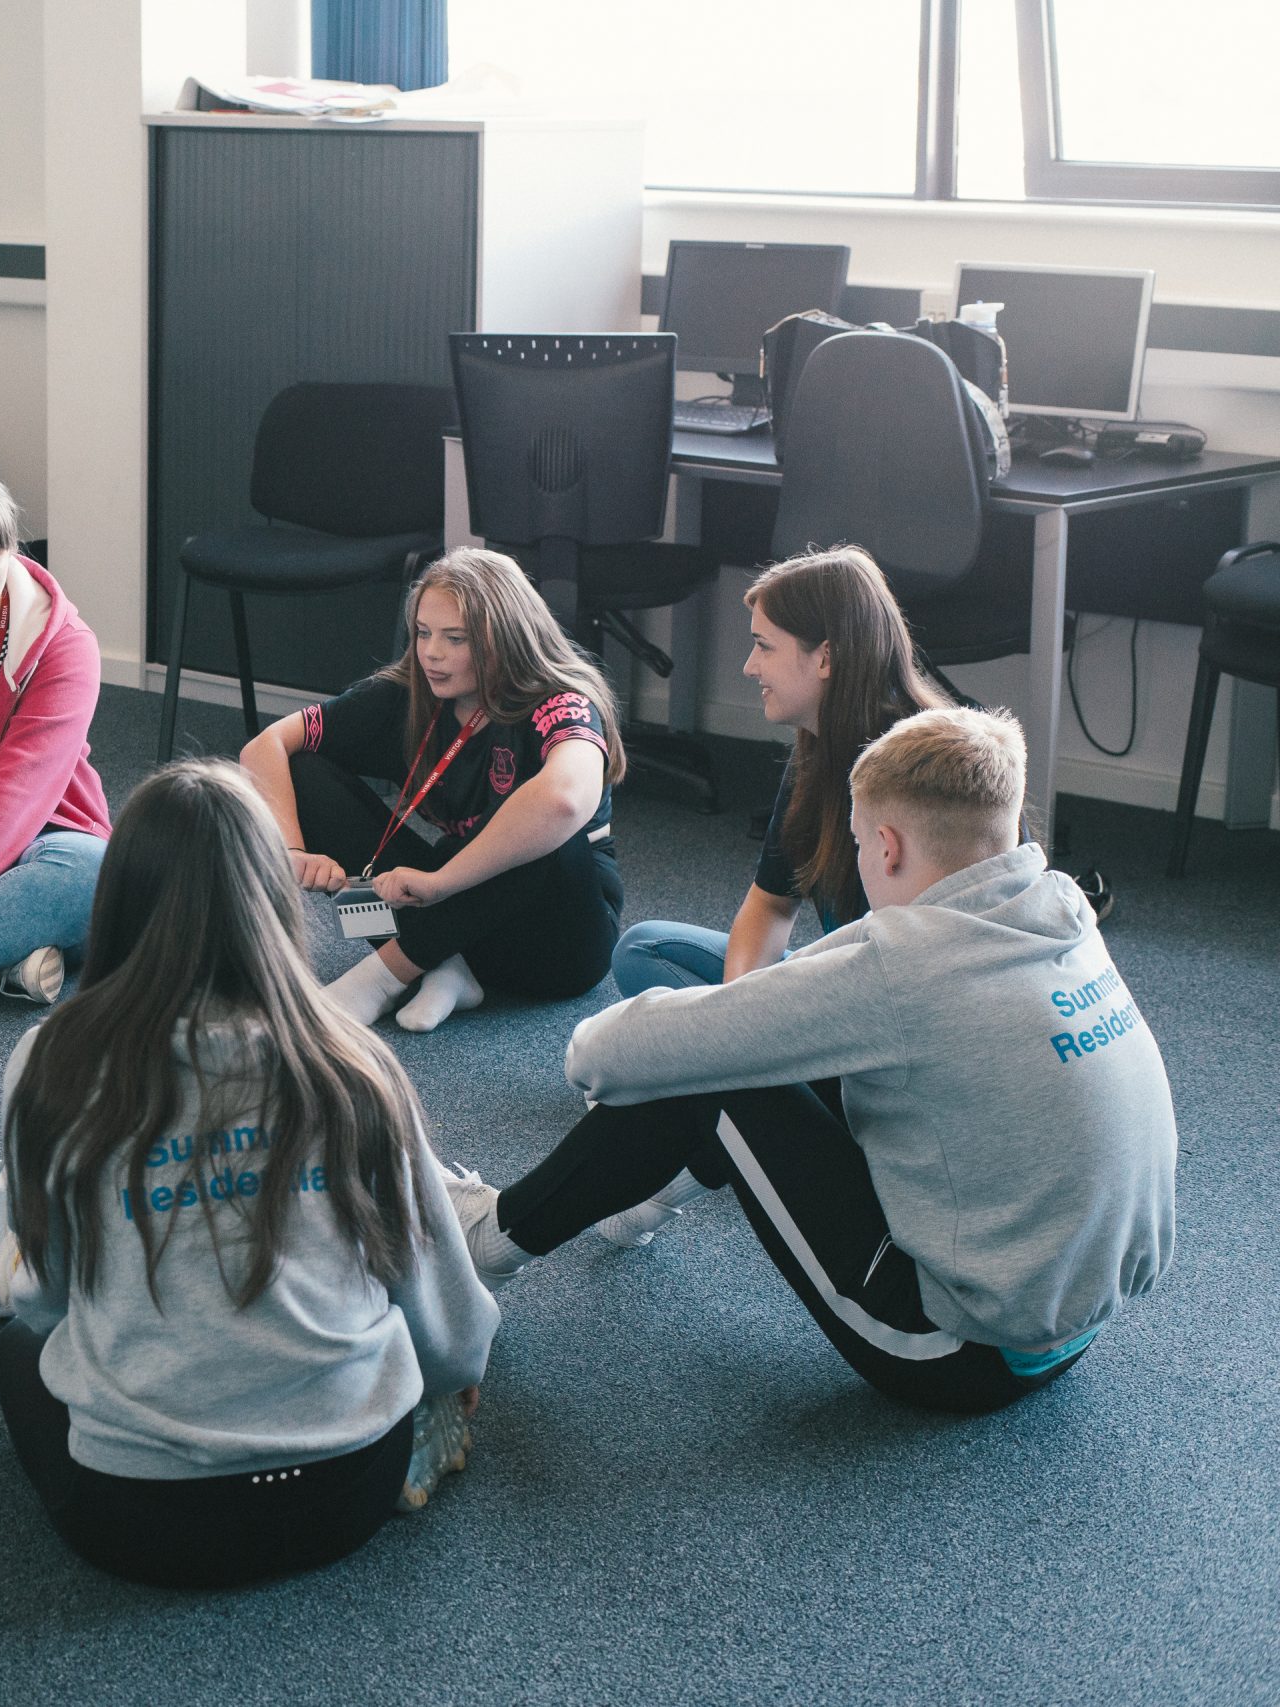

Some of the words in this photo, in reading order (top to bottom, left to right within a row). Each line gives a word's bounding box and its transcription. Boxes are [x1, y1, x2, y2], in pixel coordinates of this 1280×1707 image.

[531, 691, 591, 724] ANGRY
[535, 706, 592, 738] BIRDS
[445, 738, 464, 761] VISITOR
[421, 772, 440, 793] VISITOR
